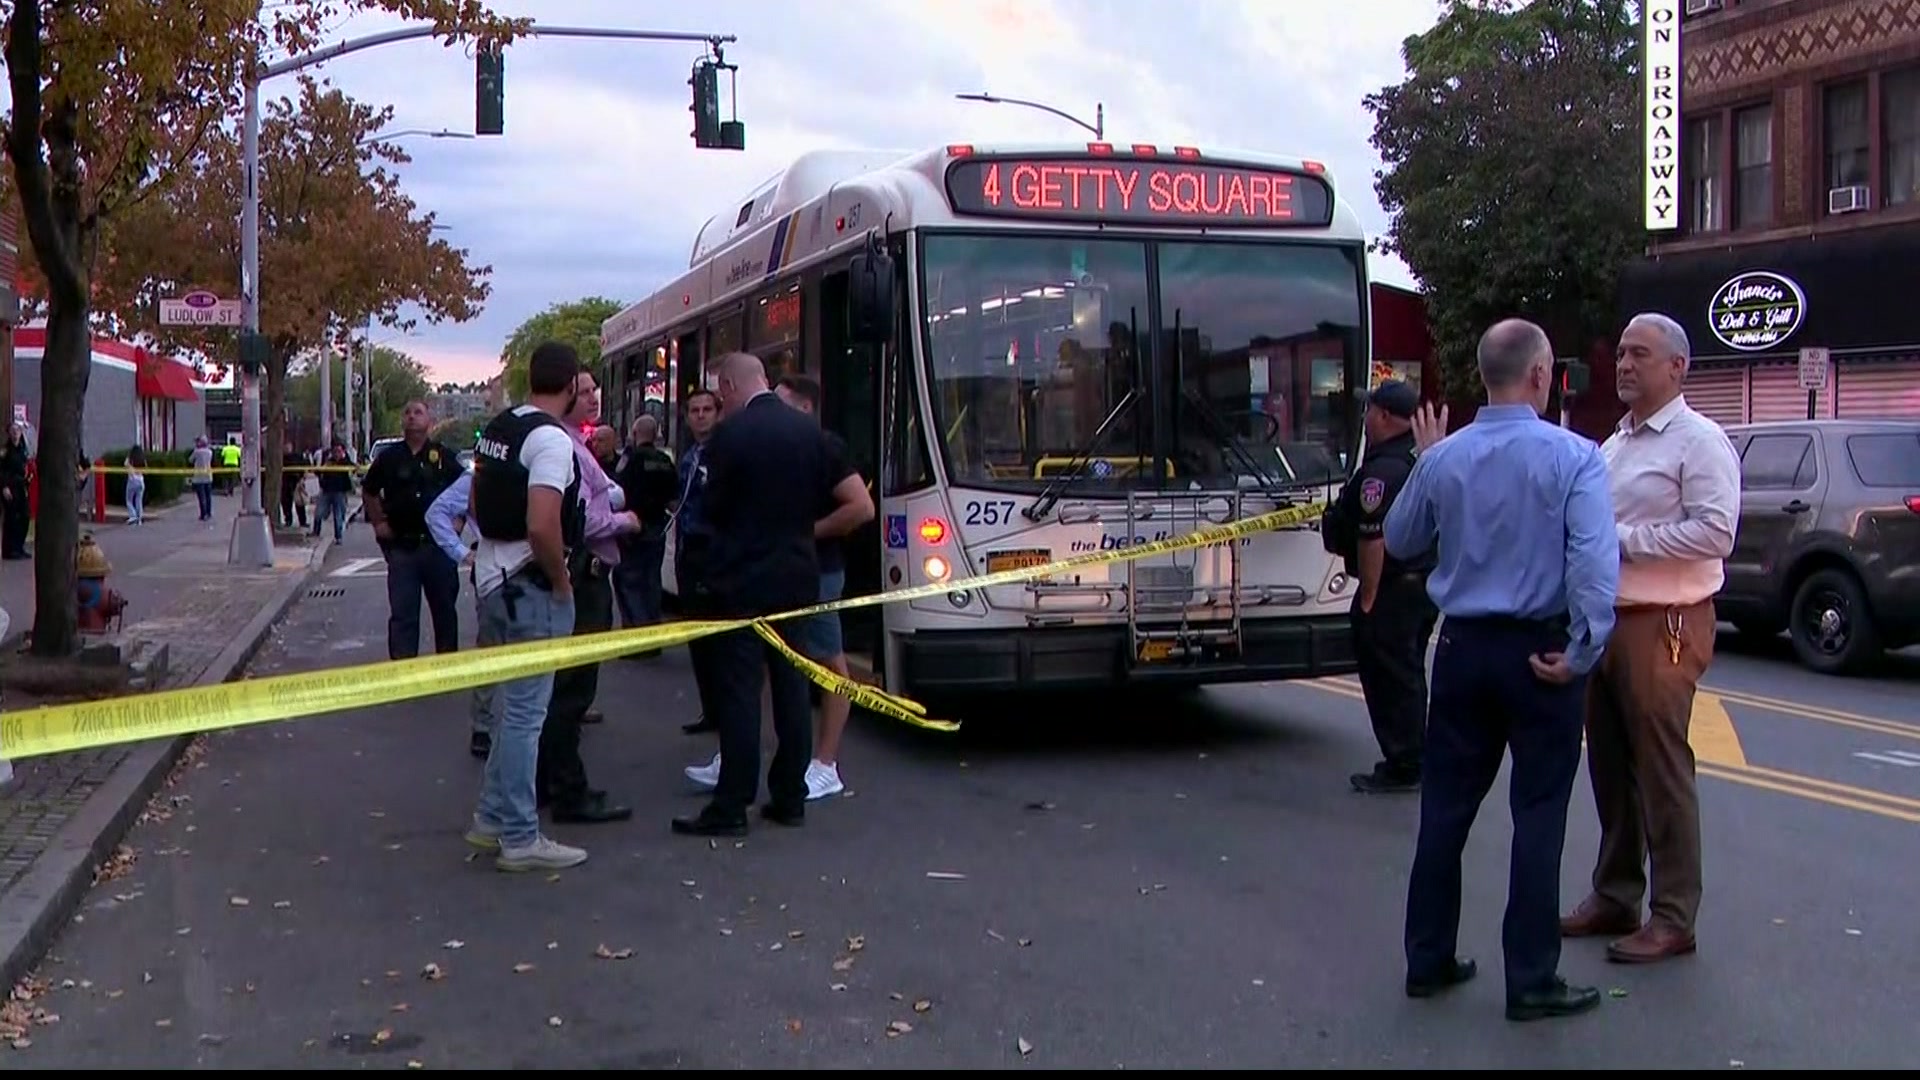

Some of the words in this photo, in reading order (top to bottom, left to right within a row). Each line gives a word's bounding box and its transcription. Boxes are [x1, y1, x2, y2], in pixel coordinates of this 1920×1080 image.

[1652, 8, 1673, 43] ON
[1650, 65, 1675, 220] BROADWAY
[984, 163, 1001, 206] 4
[1011, 165, 1139, 210] GETTY
[1148, 171, 1292, 217] SQUARE
[168, 308, 214, 322] LUDLOW
[219, 309, 232, 323] ST
[1718, 312, 1746, 330] Deli
[1748, 310, 1761, 327] &
[1765, 306, 1794, 331] Grill
[1808, 350, 1820, 360] NO
[965, 501, 1016, 526] 257
[1071, 539, 1096, 552] the
